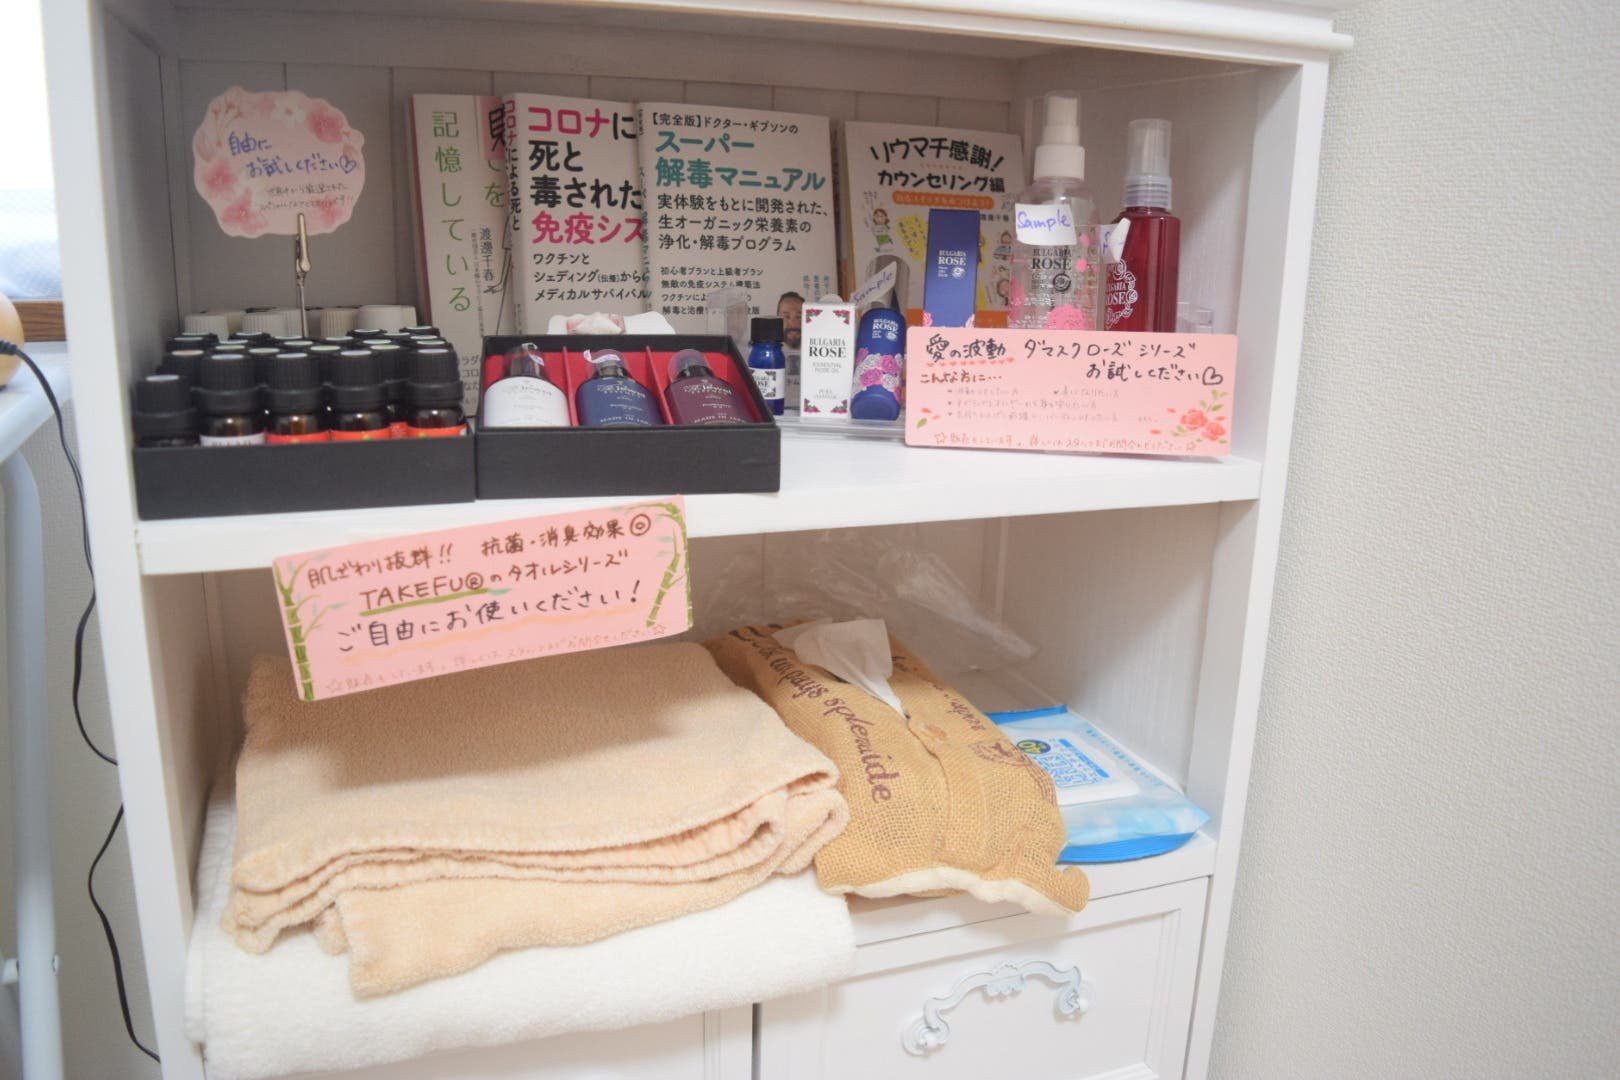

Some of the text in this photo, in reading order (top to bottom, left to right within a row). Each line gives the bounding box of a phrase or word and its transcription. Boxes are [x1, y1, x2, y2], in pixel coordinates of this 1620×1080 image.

[527, 106, 637, 140] コロナに
[228, 131, 273, 156] 自由に
[656, 131, 755, 153] スーパー
[528, 140, 584, 172] 死と
[870, 137, 1005, 172] リウマチ感謝!
[656, 156, 826, 192] 解毒マニュアル
[878, 170, 1006, 192] カウンセリング編
[530, 174, 642, 211] 毒された
[431, 111, 471, 313] 記憶している
[657, 193, 828, 216] 実体験をもとに開発された、
[658, 214, 812, 233] 生オーガニック栄養素の
[1017, 208, 1072, 229] Sample
[658, 233, 797, 252] 浄化・解毒プログラム
[533, 253, 590, 265] ワクチンと
[938, 256, 967, 266] ROSE
[1031, 257, 1072, 270] ROSE
[809, 346, 847, 358] ROSE
[926, 333, 1006, 362] 愛の波動
